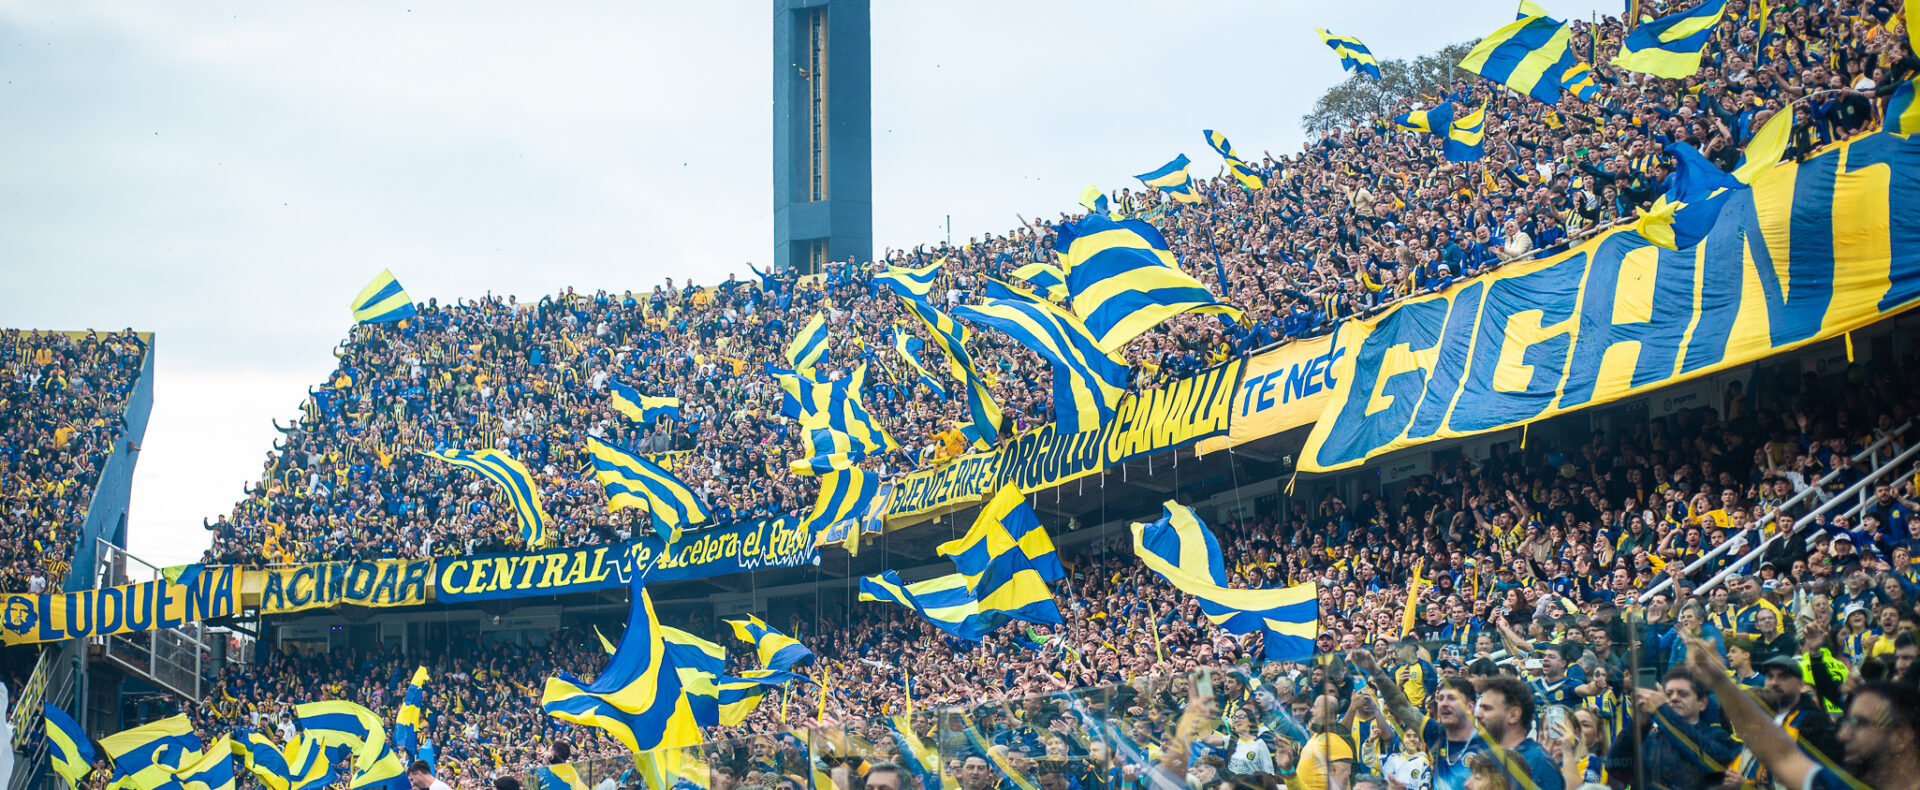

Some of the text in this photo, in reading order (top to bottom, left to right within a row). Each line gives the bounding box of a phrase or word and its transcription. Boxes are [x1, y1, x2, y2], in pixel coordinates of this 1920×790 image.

[1108, 359, 1241, 463] CANALLA
[1242, 368, 1284, 417] TE
[891, 463, 957, 514] BUENOS
[951, 451, 1002, 499] AIRES
[996, 424, 1101, 492] ORGULLO
[261, 561, 431, 610] ACINDAR
[441, 547, 611, 594] CENTRAL
[743, 521, 766, 557] el
